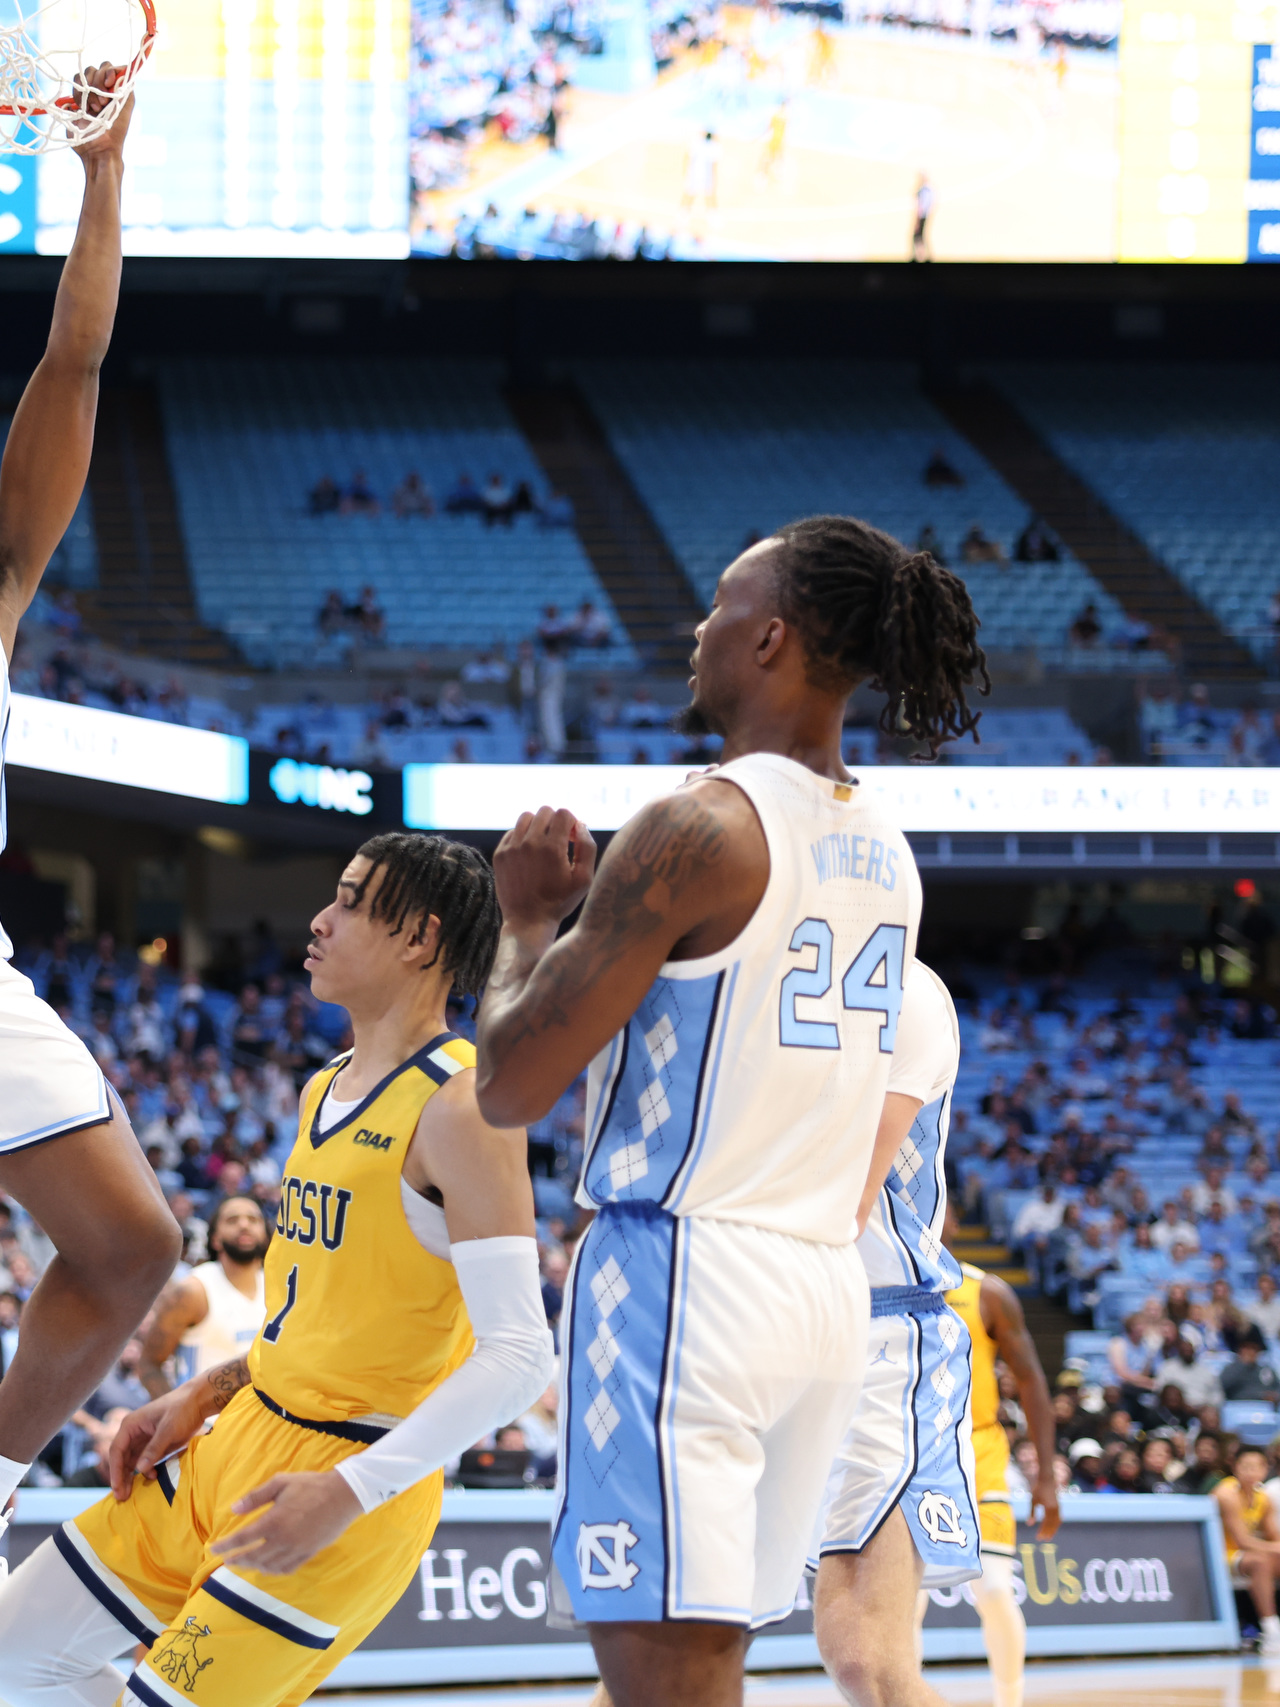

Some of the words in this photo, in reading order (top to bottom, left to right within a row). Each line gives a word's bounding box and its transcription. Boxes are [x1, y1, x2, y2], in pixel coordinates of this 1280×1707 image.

[810, 832, 899, 892] WITHERS
[779, 916, 907, 1055] 24
[353, 1128, 392, 1152] CIAA
[261, 1262, 299, 1345] 1
